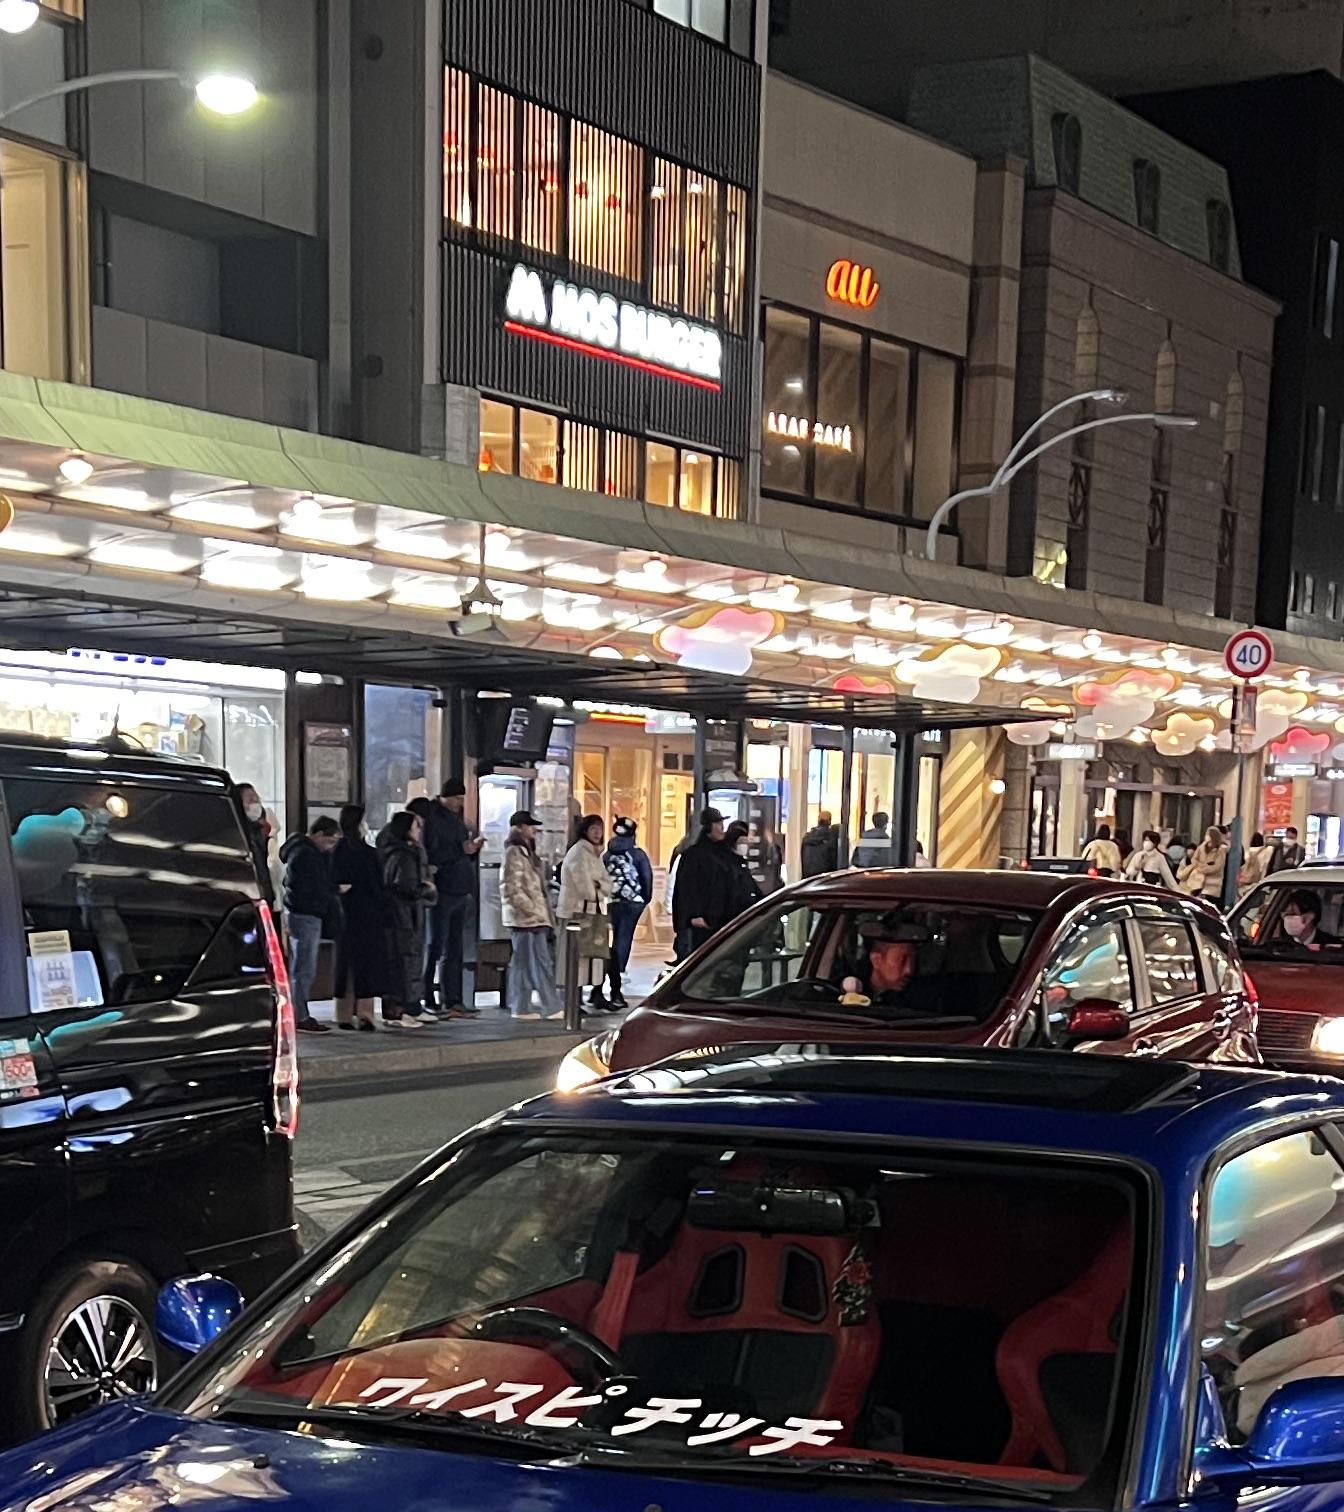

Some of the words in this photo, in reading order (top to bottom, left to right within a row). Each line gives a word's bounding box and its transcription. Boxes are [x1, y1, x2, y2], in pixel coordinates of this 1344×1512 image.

[826, 259, 880, 307] au
[550, 279, 618, 348] MOS
[1236, 644, 1262, 666] 40
